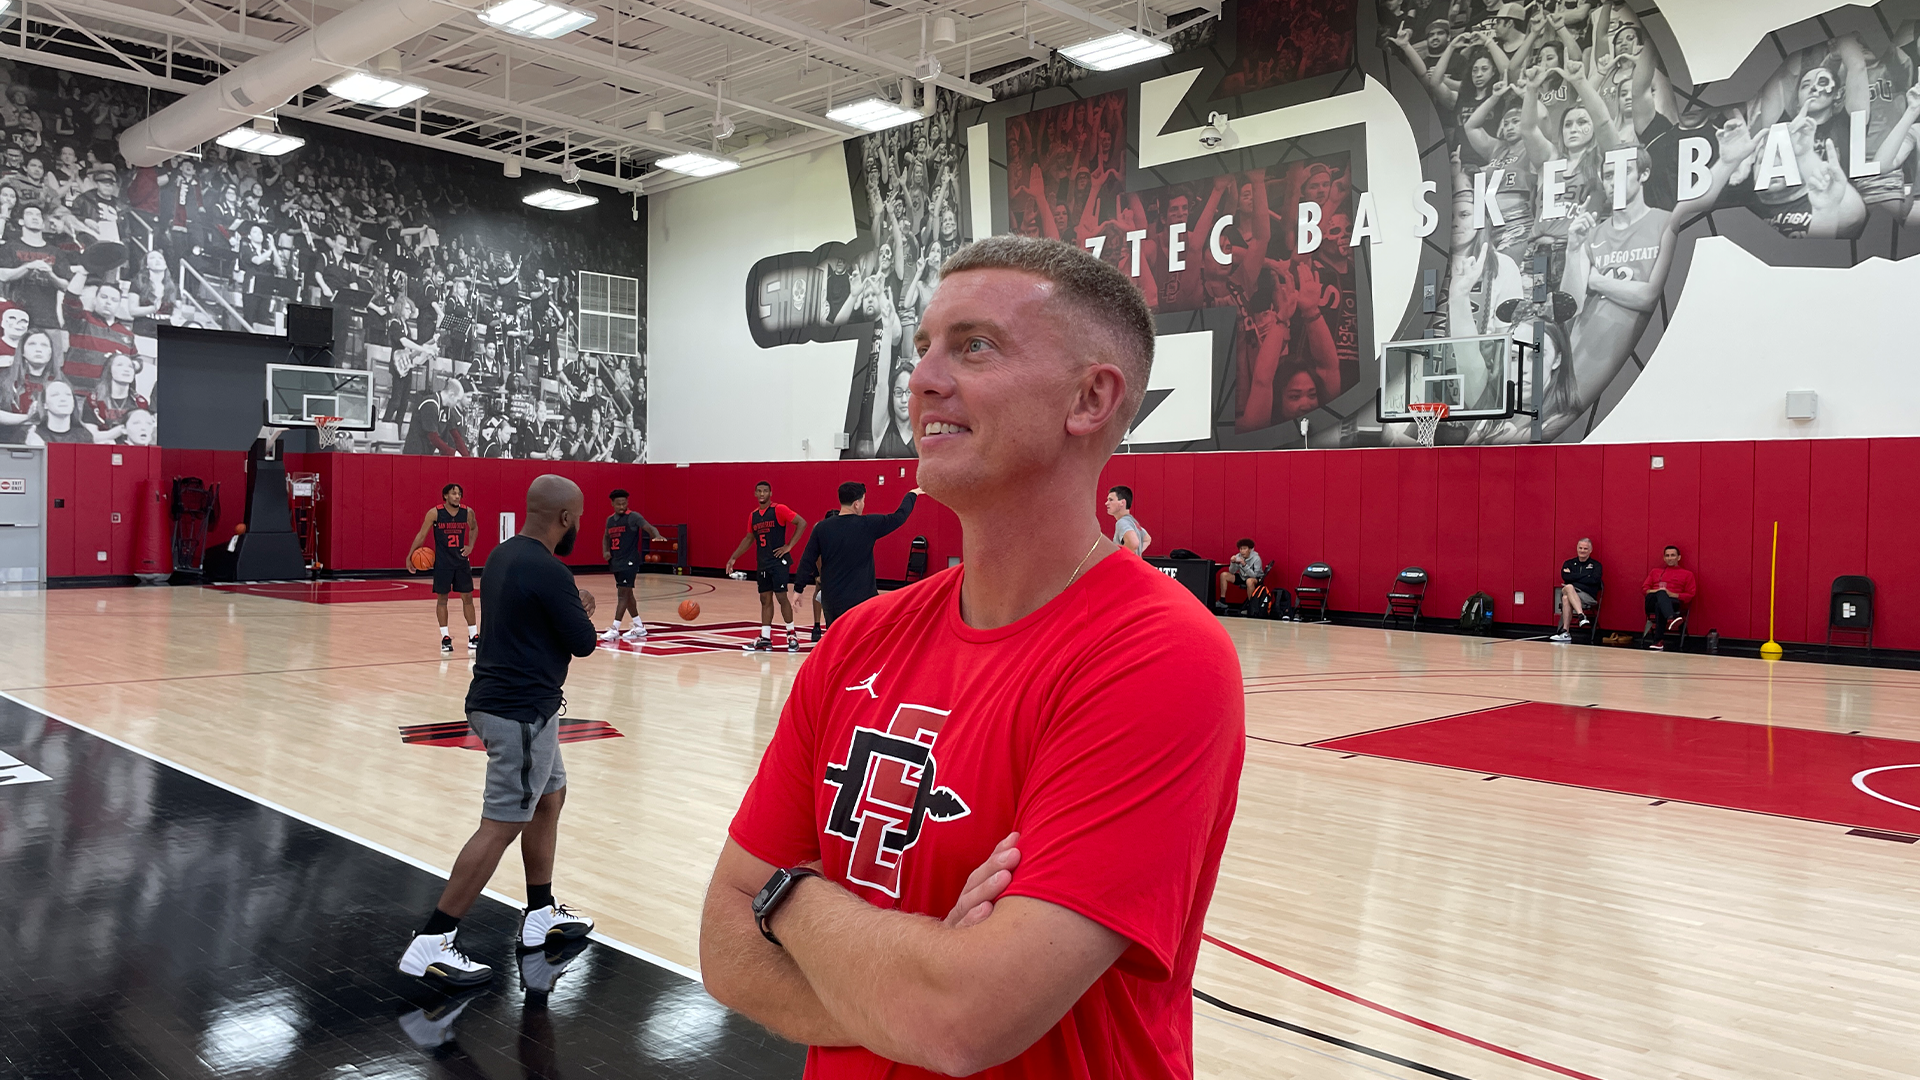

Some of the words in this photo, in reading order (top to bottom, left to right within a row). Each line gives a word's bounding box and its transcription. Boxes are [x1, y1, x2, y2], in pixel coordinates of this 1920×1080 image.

[1084, 213, 1234, 278] ZTEC
[447, 534, 460, 548] 21
[759, 533, 767, 547] 5
